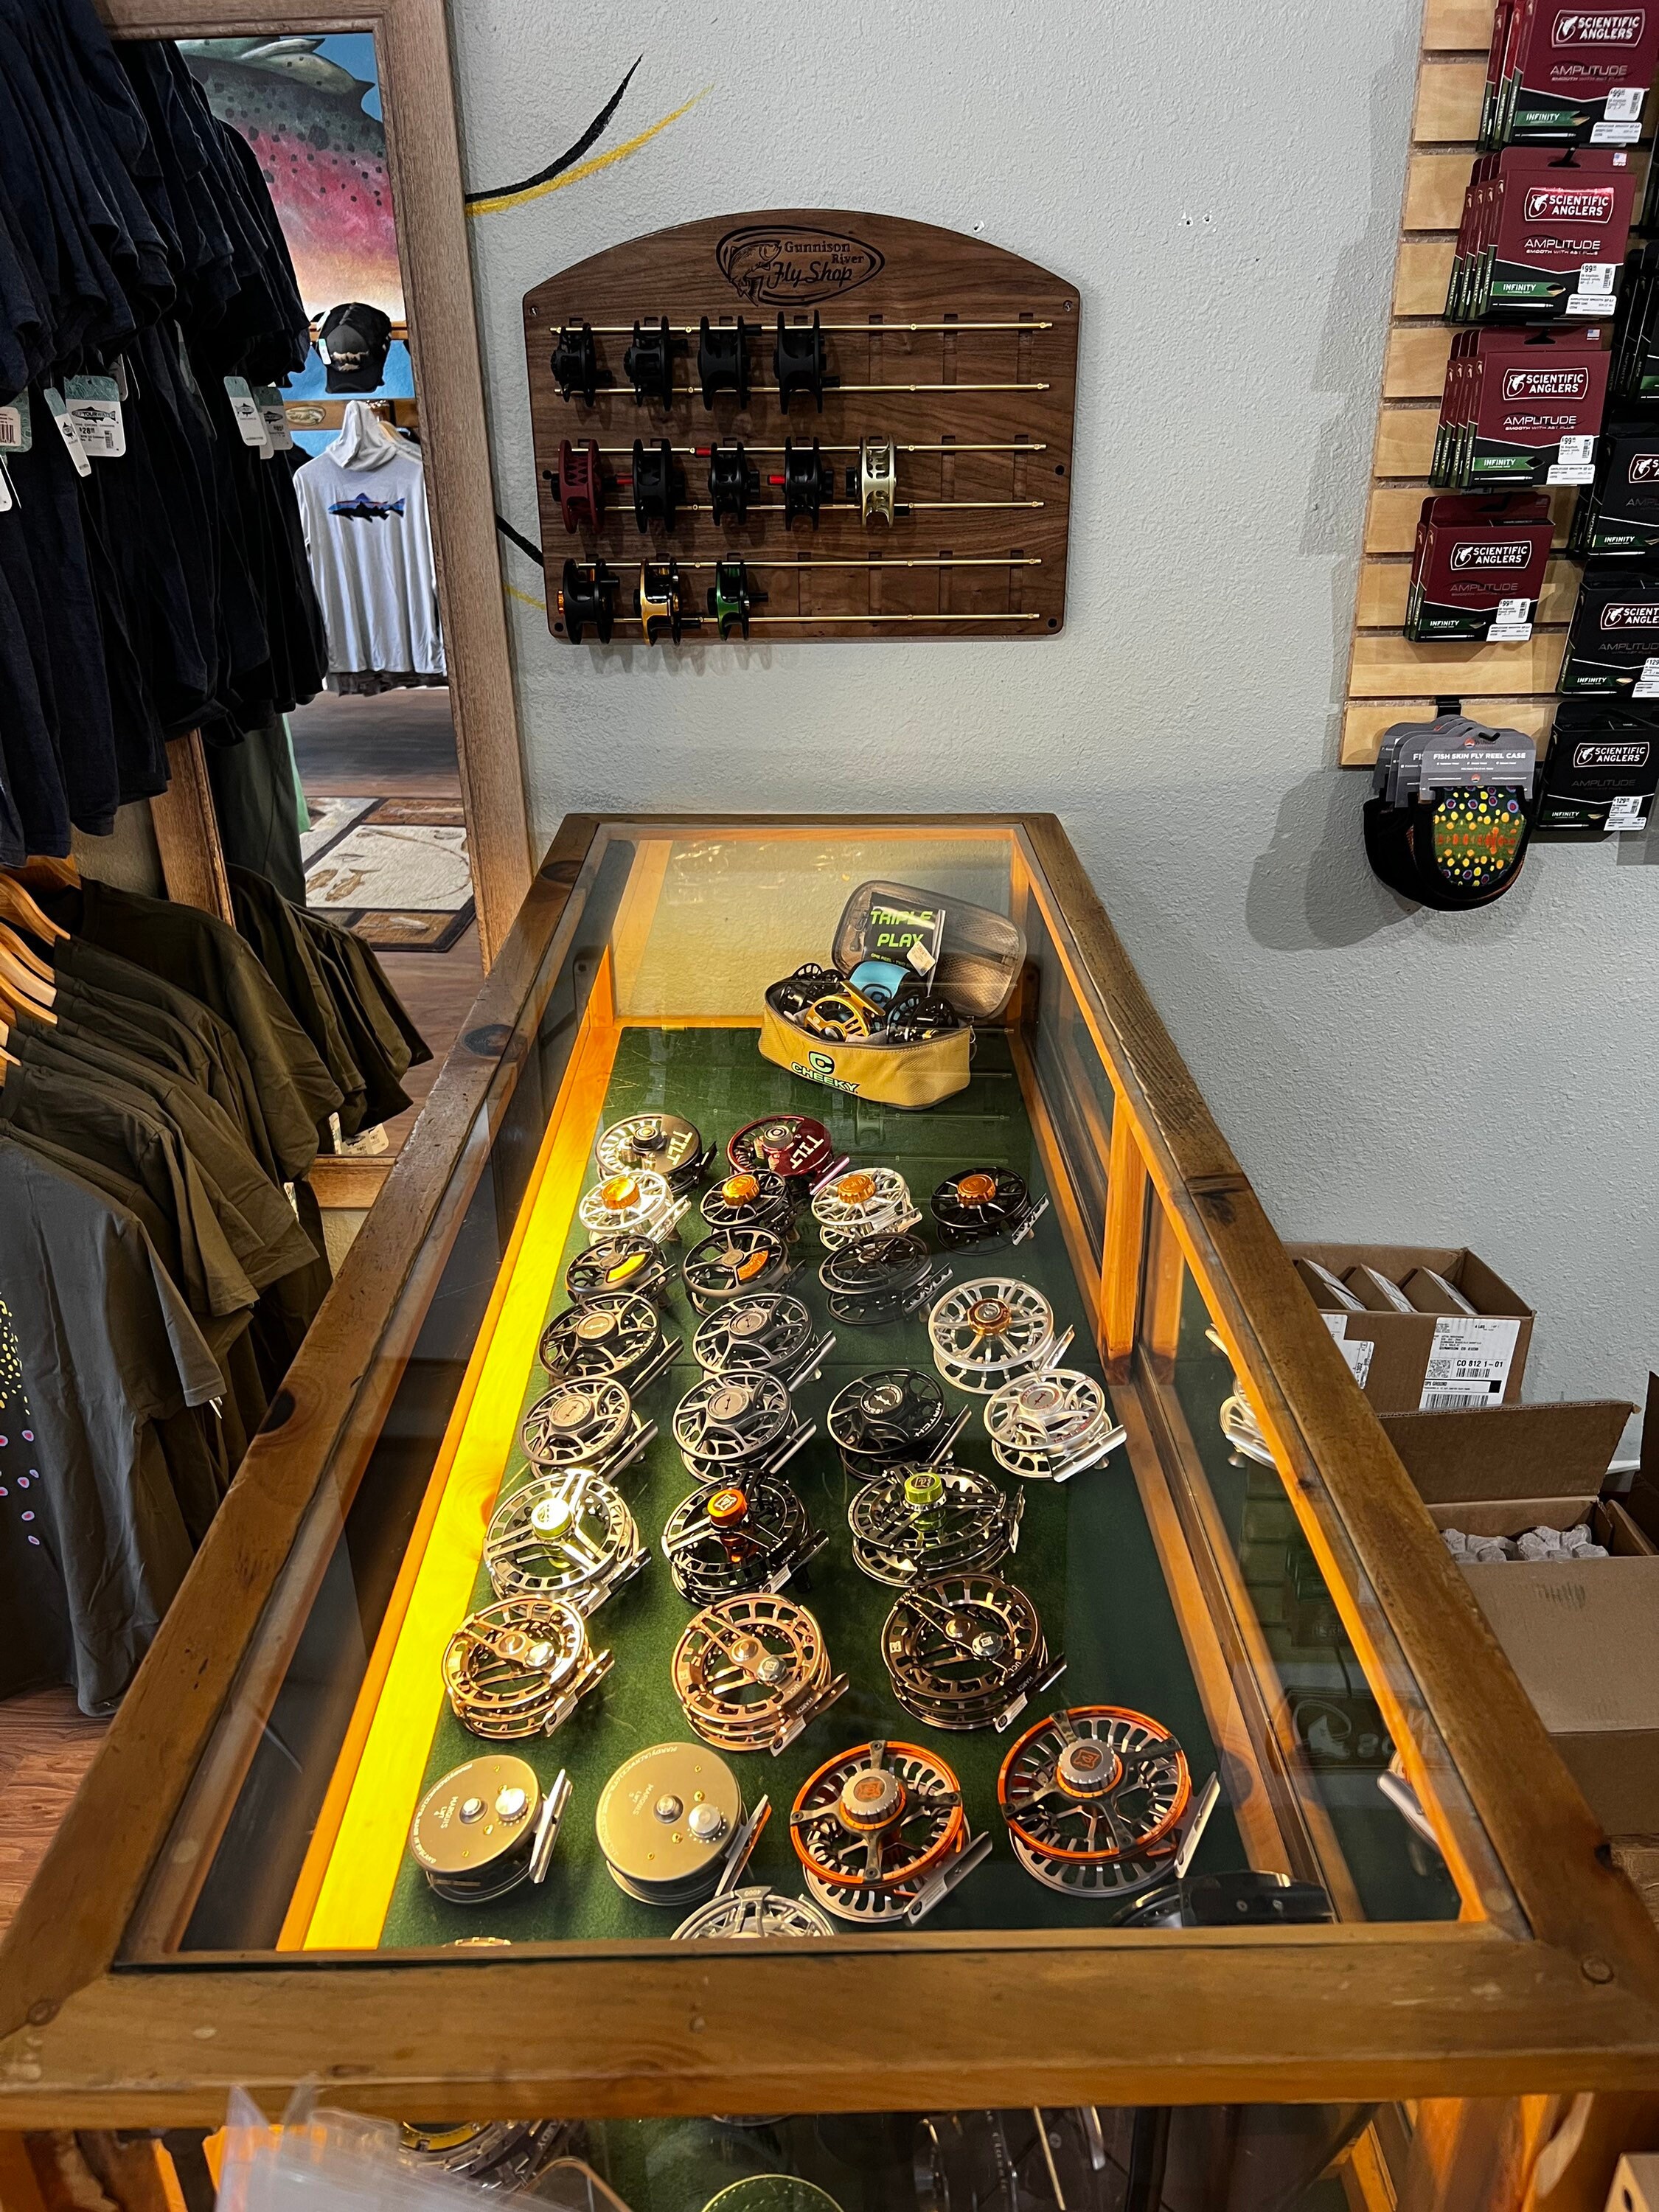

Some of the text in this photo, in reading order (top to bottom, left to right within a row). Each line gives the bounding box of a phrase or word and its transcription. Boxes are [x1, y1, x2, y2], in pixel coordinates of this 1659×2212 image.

[1578, 16, 1640, 29] SCIENTIFIC
[1579, 28, 1633, 40] ANGLERS
[1550, 65, 1628, 76] AMPLITUDE
[1526, 113, 1560, 121] INFINITY
[1549, 195, 1609, 206] SCIENTIFIC
[1552, 206, 1604, 216] ANGLERS
[785, 240, 850, 253] Gunnison
[1524, 238, 1601, 250] AMPLITUDE
[831, 253, 864, 265] River
[766, 260, 852, 290] Fly Shop
[1503, 283, 1537, 291] INFINITY
[1526, 374, 1584, 384] SCIENTIFIC
[1528, 383, 1579, 393] ANGLERS
[1503, 415, 1577, 425] AMPLITUDE
[1472, 546, 1528, 556] SCIENTIFIC
[1475, 554, 1523, 564] ANGLERS
[1450, 582, 1519, 591] AMPLITUDE
[1623, 608, 1659, 616] SCIENT
[1624, 616, 1659, 624] ANGLE
[1598, 642, 1659, 650] AMPLITUD
[1594, 747, 1646, 755] SCIENTIFIC
[1596, 754, 1641, 762] ANGLERS
[1571, 779, 1637, 787] AMPLITUDE
[871, 911, 933, 925] TRIPLE
[877, 933, 924, 947] PLAY
[791, 1062, 860, 1092] CHEEKY
[667, 1130, 692, 1166] TILT
[790, 1135, 824, 1169] TILT
[914, 1402, 942, 1437] HATCH
[781, 1550, 796, 1565] HARDY
[1008, 1661, 1022, 1672] UCL
[787, 1683, 801, 1694] UCL
[1016, 1675, 1033, 1692] HARDY
[796, 1697, 813, 1714] HARDY
[633, 1783, 654, 1816] MARQUIS
[440, 1796, 459, 1829] MARQUIS
